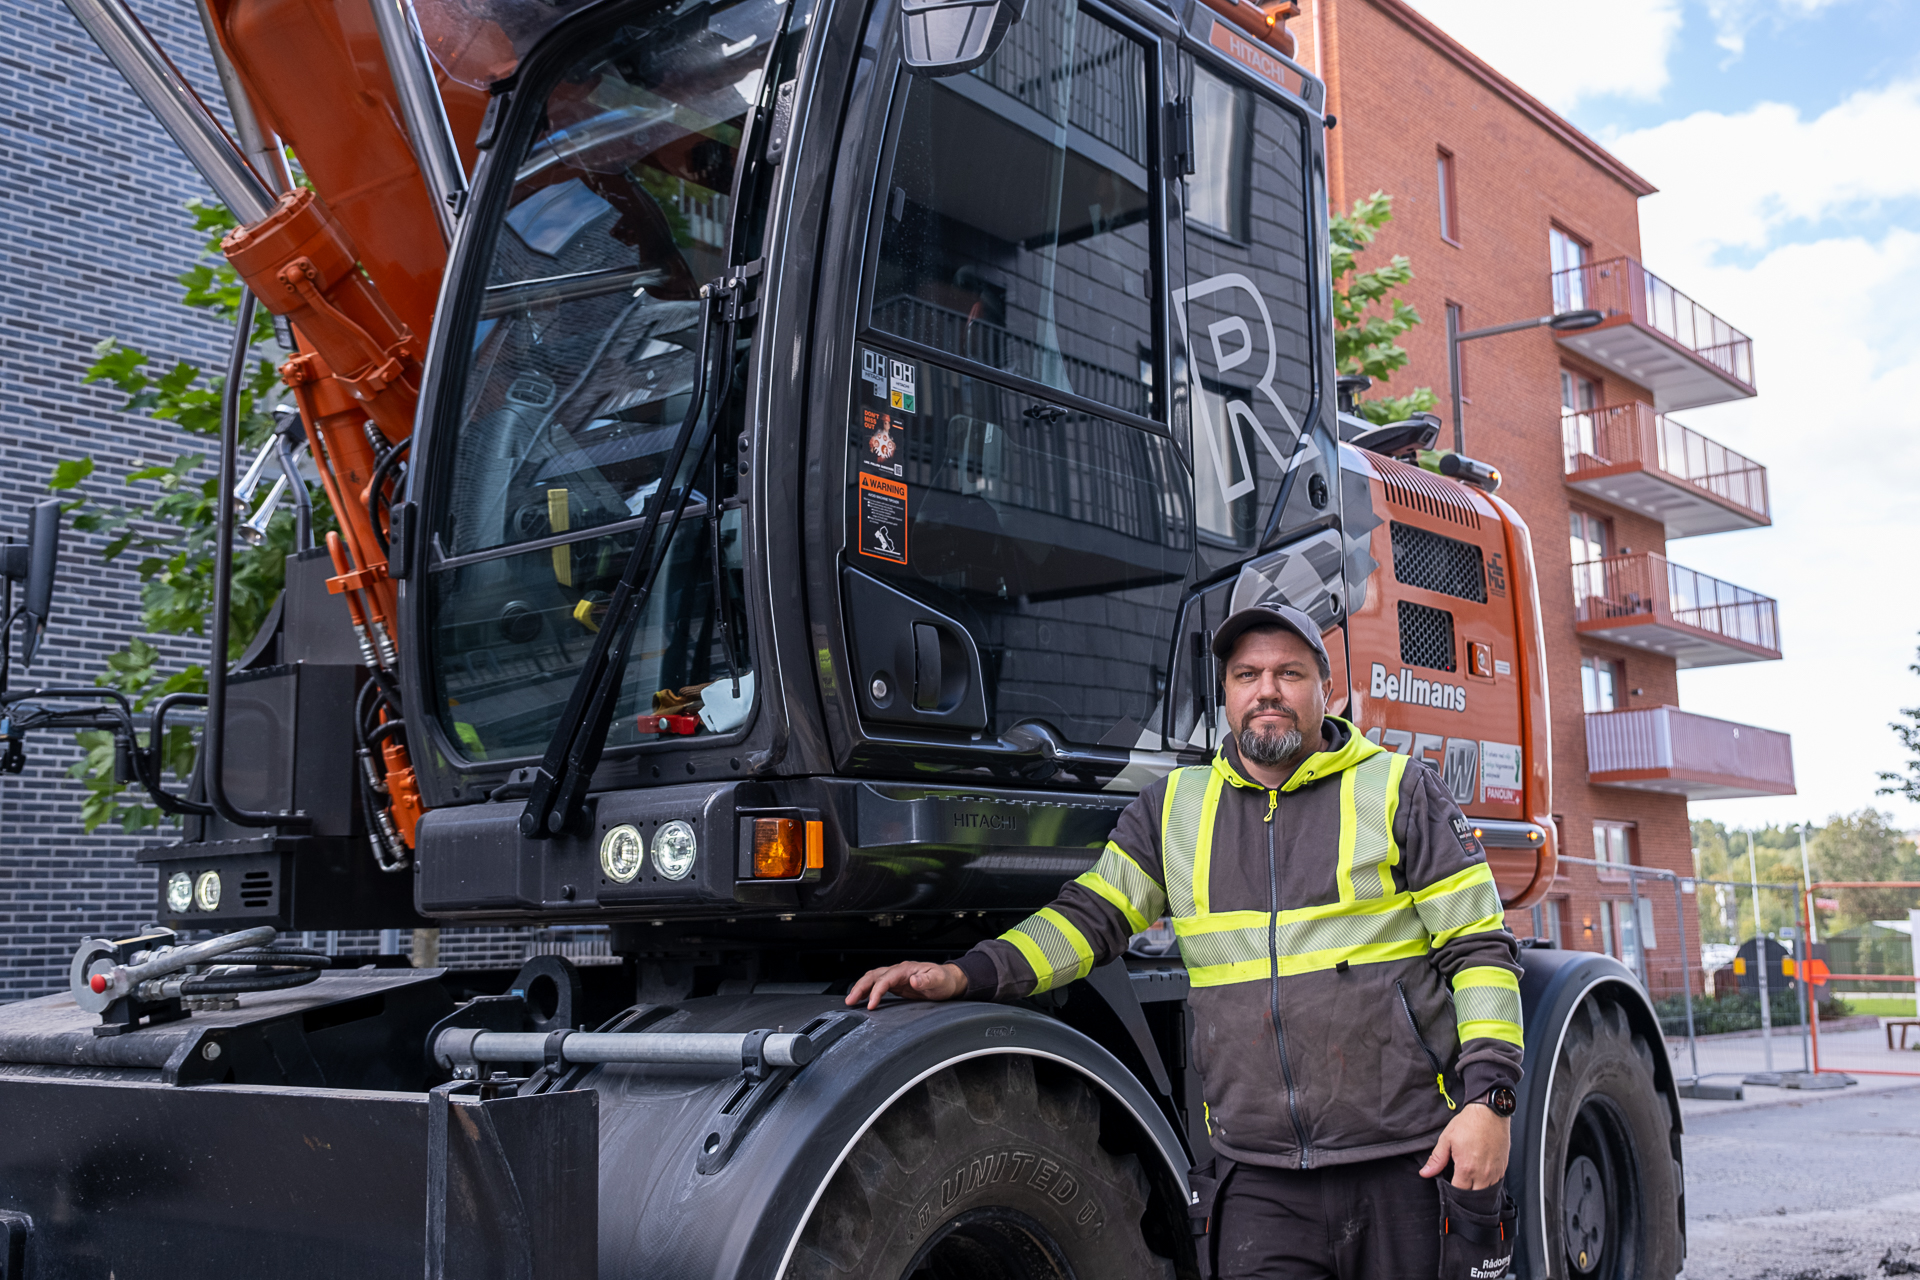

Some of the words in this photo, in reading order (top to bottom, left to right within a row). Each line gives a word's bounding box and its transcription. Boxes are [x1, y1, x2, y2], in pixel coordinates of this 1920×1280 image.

[1229, 35, 1286, 84] HITACHI
[864, 371, 885, 383] HITACHI
[864, 410, 880, 420] DON'T
[864, 415, 877, 425] MISS
[863, 422, 875, 430] OUT
[869, 478, 905, 497] WARNING
[1370, 662, 1466, 712] Bellmans
[953, 813, 1017, 831] HITACHI
[940, 1151, 1080, 1210] UNITED
